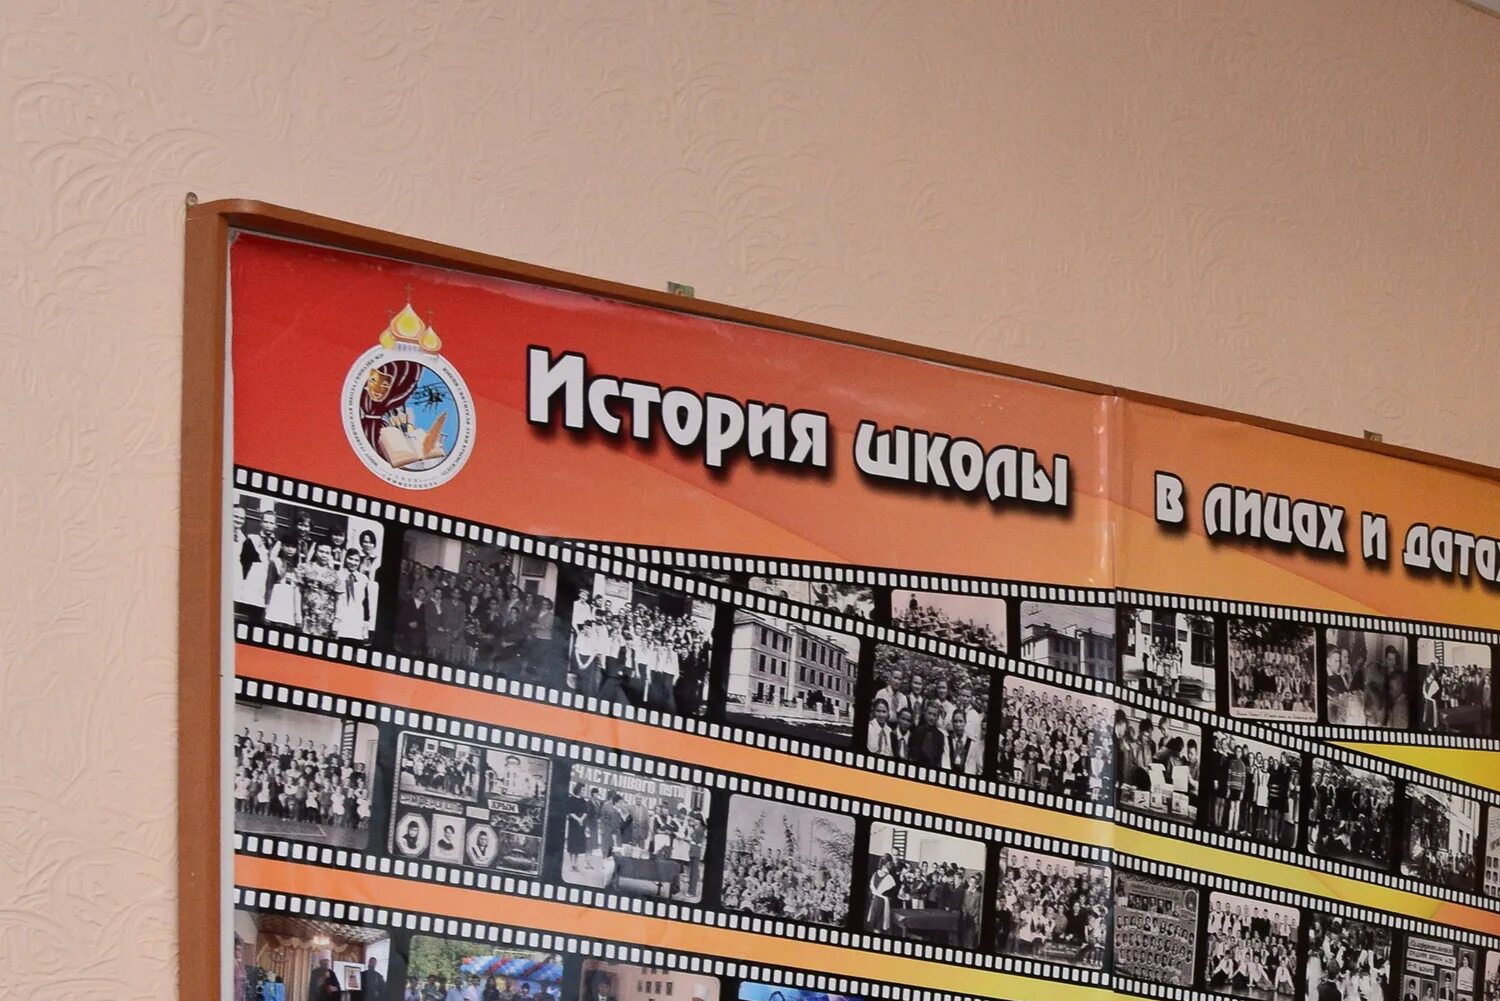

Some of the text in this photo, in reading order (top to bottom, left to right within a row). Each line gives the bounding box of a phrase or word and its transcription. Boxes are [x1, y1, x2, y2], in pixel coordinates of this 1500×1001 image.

[527, 345, 829, 467] История
[853, 422, 1069, 505] школы
[1154, 471, 1185, 524] в
[1203, 483, 1345, 553] лицах
[1361, 512, 1388, 560] и
[571, 765, 656, 795] ЧАСТЛИВОГО
